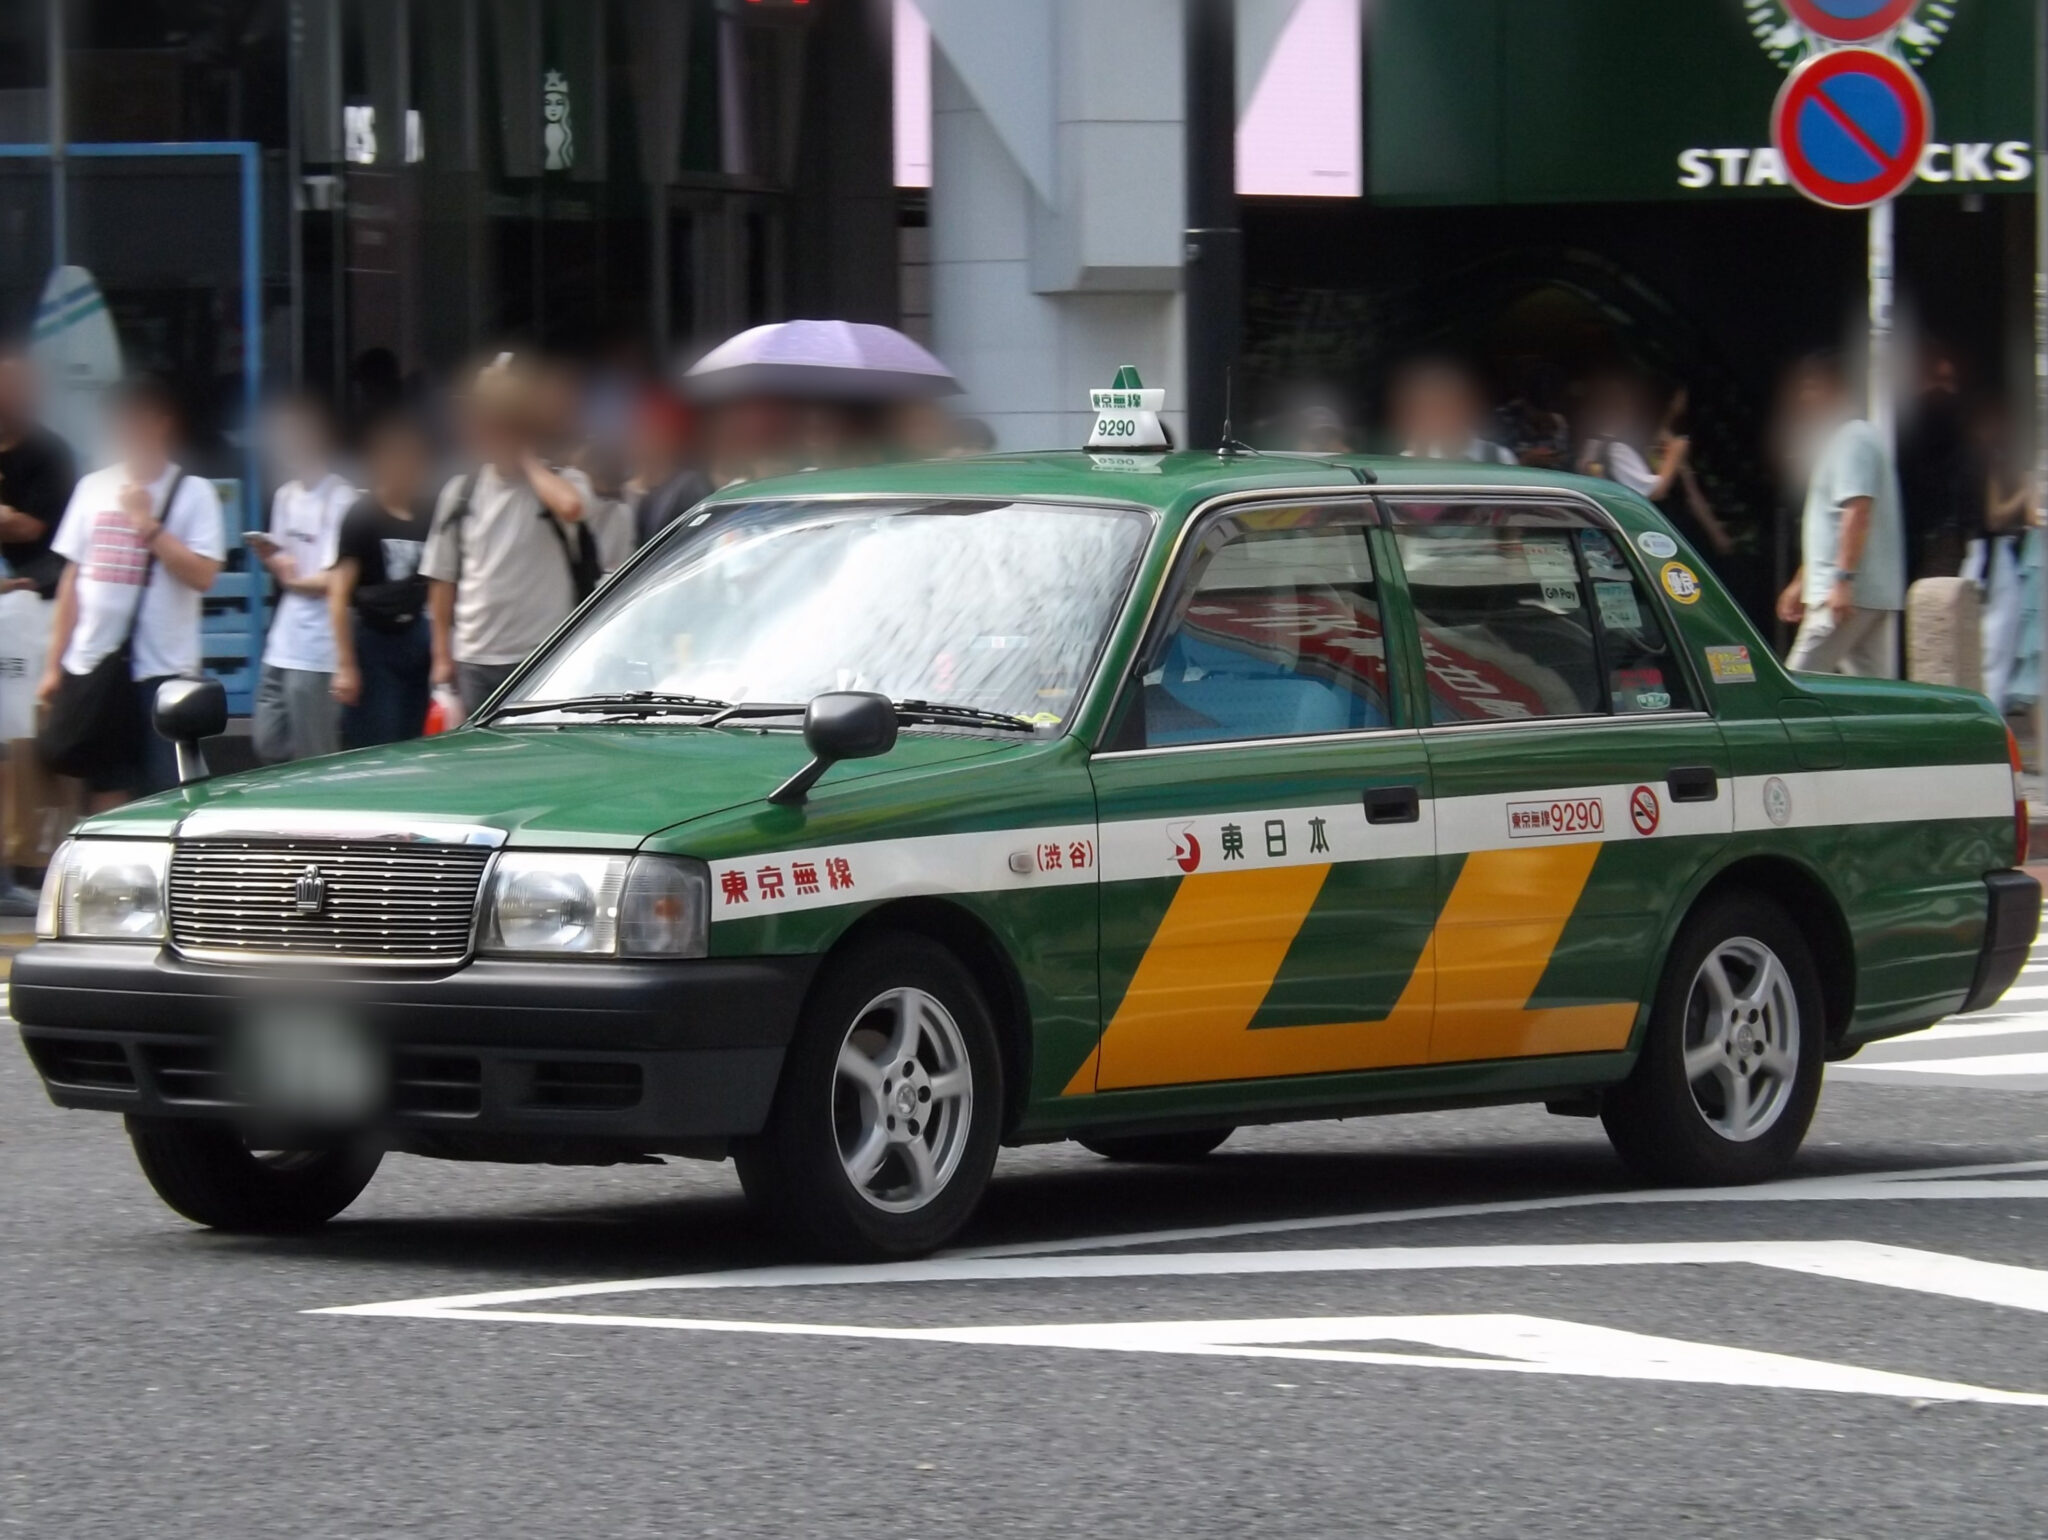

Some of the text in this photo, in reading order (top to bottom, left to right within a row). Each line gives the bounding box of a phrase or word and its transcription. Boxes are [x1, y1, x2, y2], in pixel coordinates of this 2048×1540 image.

[1677, 141, 2032, 188] STACKS
[1098, 420, 1135, 436] 9290
[1220, 816, 1330, 861] 東日本
[1551, 801, 1601, 832] 9290
[720, 857, 855, 905] 東京無線
